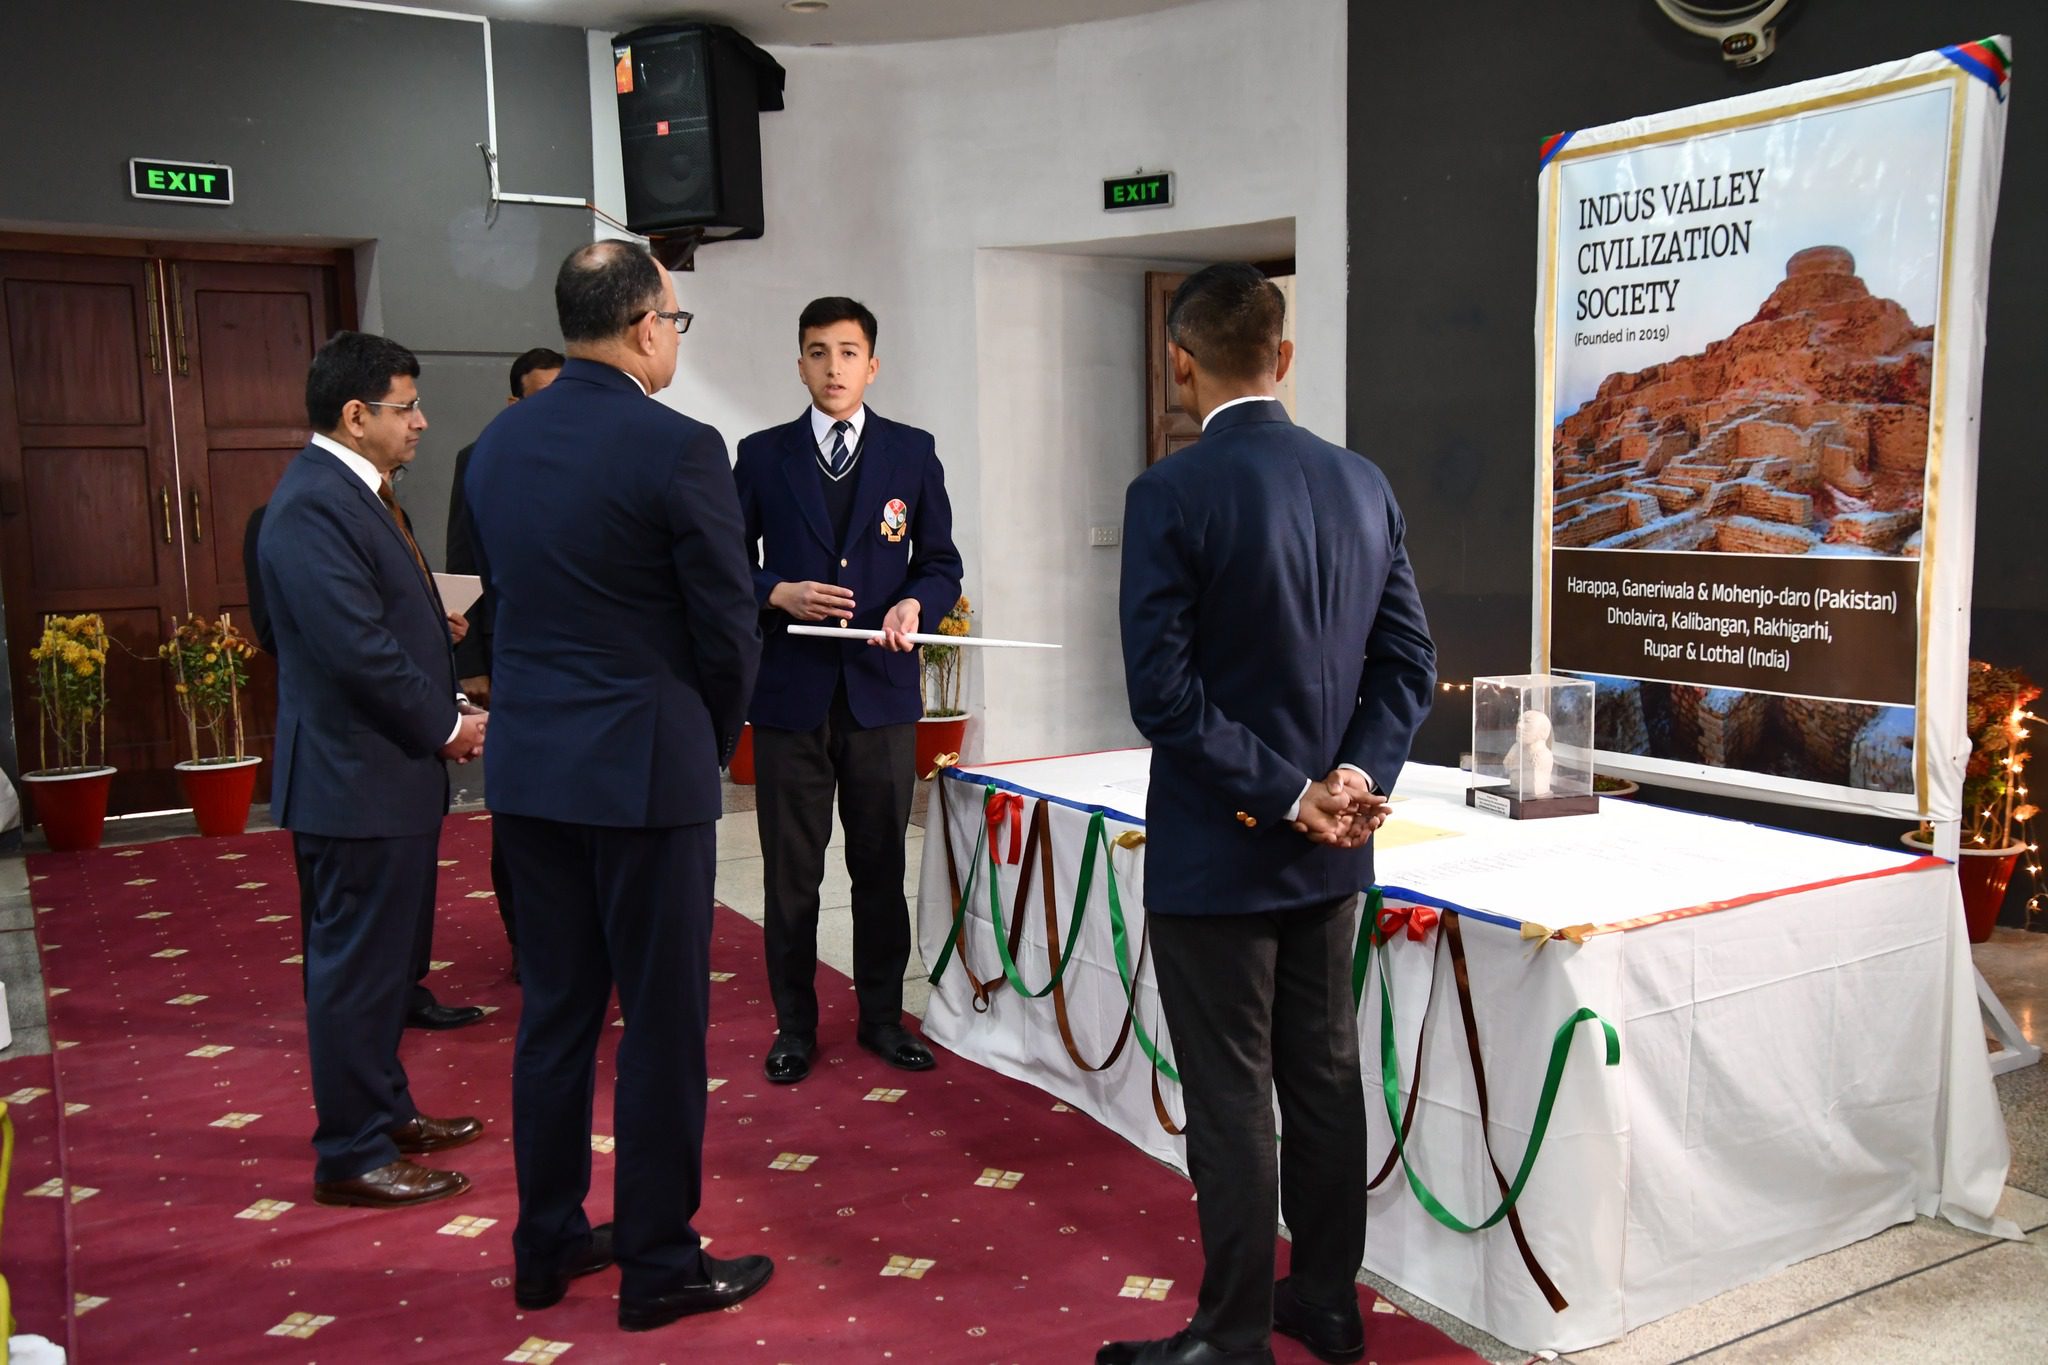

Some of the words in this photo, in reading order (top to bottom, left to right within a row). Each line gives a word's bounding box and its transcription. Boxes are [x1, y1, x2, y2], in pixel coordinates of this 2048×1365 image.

[148, 169, 216, 193] EXIT
[1113, 181, 1160, 203] EXIT
[1579, 187, 1656, 230] INDUS
[1661, 168, 1765, 216] VALLEY
[1577, 220, 1752, 275] CIVILIZATION
[1576, 279, 1680, 321] SOCIETY
[1574, 329, 1623, 347] (Founded
[1626, 328, 1636, 342] in
[1639, 325, 1670, 342] 2019)
[1567, 576, 1619, 599] Harappa,
[1622, 579, 1694, 600] Ganeriwala
[1697, 582, 1709, 600] &
[1712, 583, 1811, 608] Mohenjo-daro
[1814, 588, 1897, 614] (Pakistan)
[1607, 607, 1668, 631] Dholavira,
[1671, 611, 1750, 637] Kalibangan,
[1754, 616, 1833, 643] Rakhigarhi,
[1643, 639, 1683, 661] Rupar
[1686, 642, 1697, 660] &
[1700, 645, 1744, 664] Lothal
[1747, 646, 1790, 672] (India)
